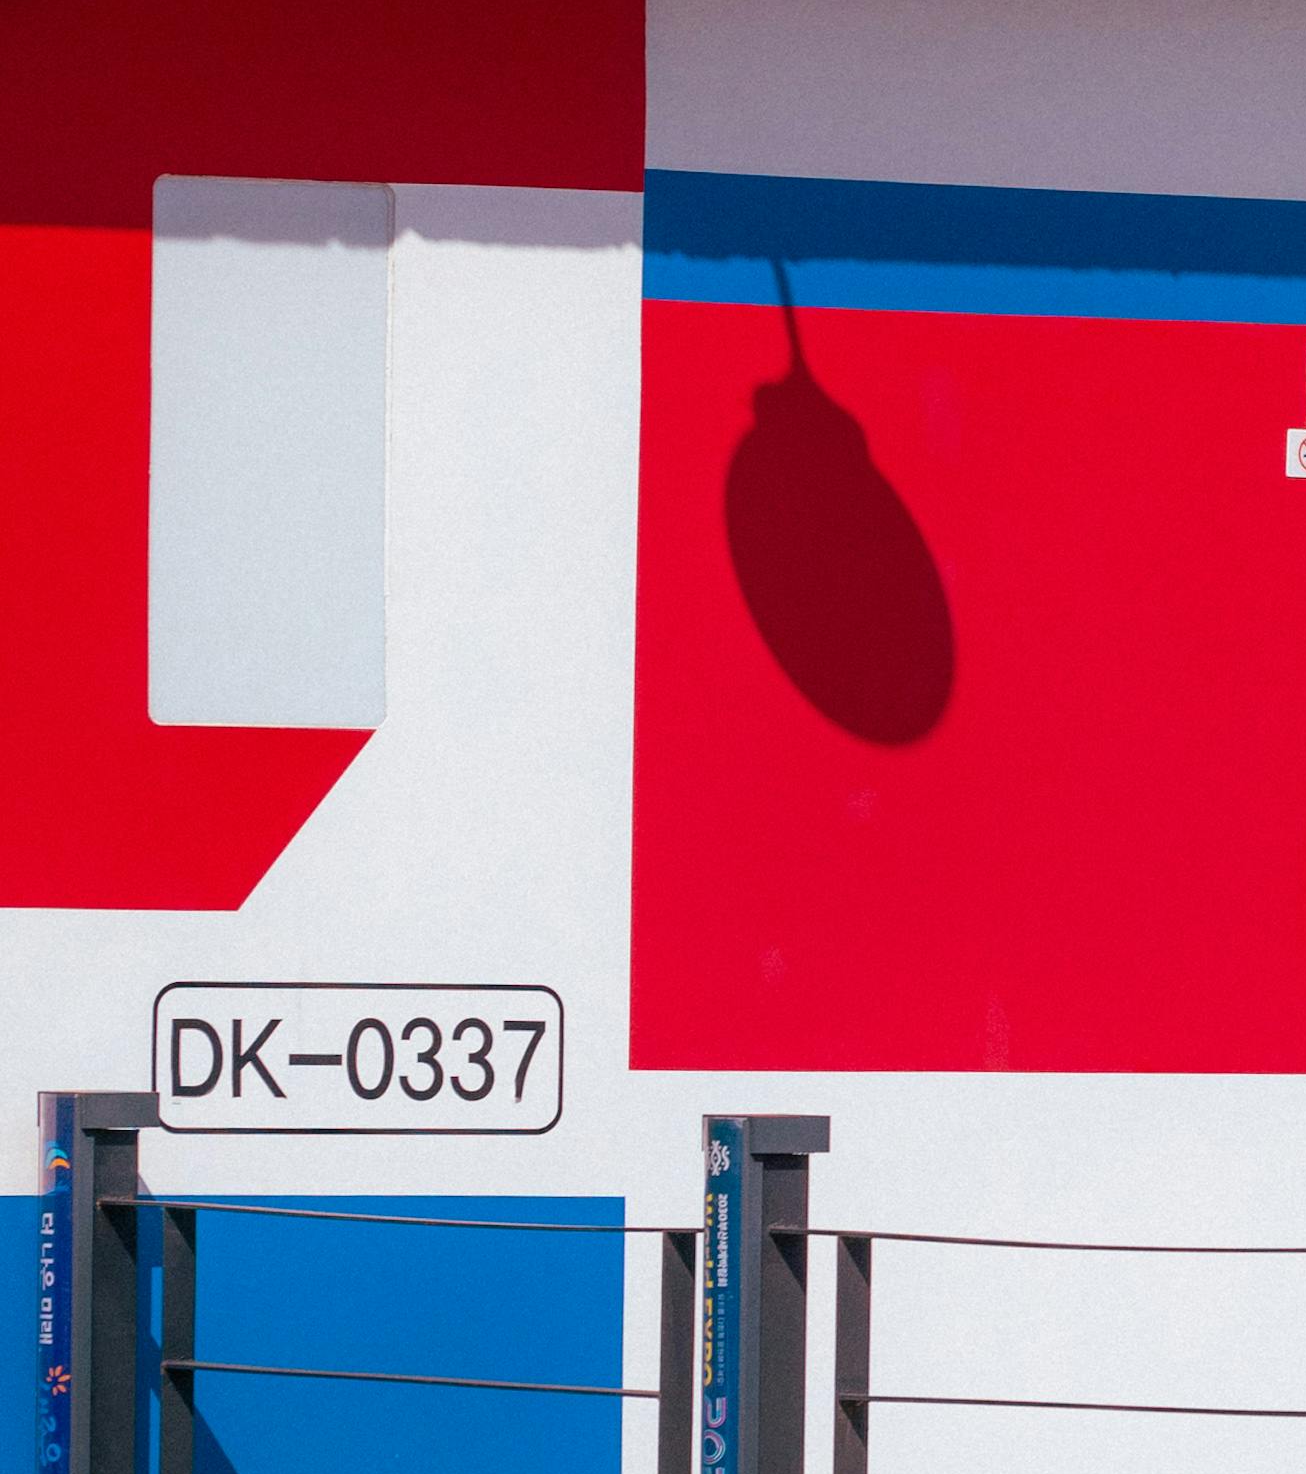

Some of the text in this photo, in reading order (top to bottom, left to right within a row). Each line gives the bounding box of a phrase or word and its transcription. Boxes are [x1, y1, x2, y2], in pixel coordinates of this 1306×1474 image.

[168, 1016, 548, 1103] DK-0337
[39, 1212, 54, 1235] 더
[39, 1242, 55, 1291] 나은
